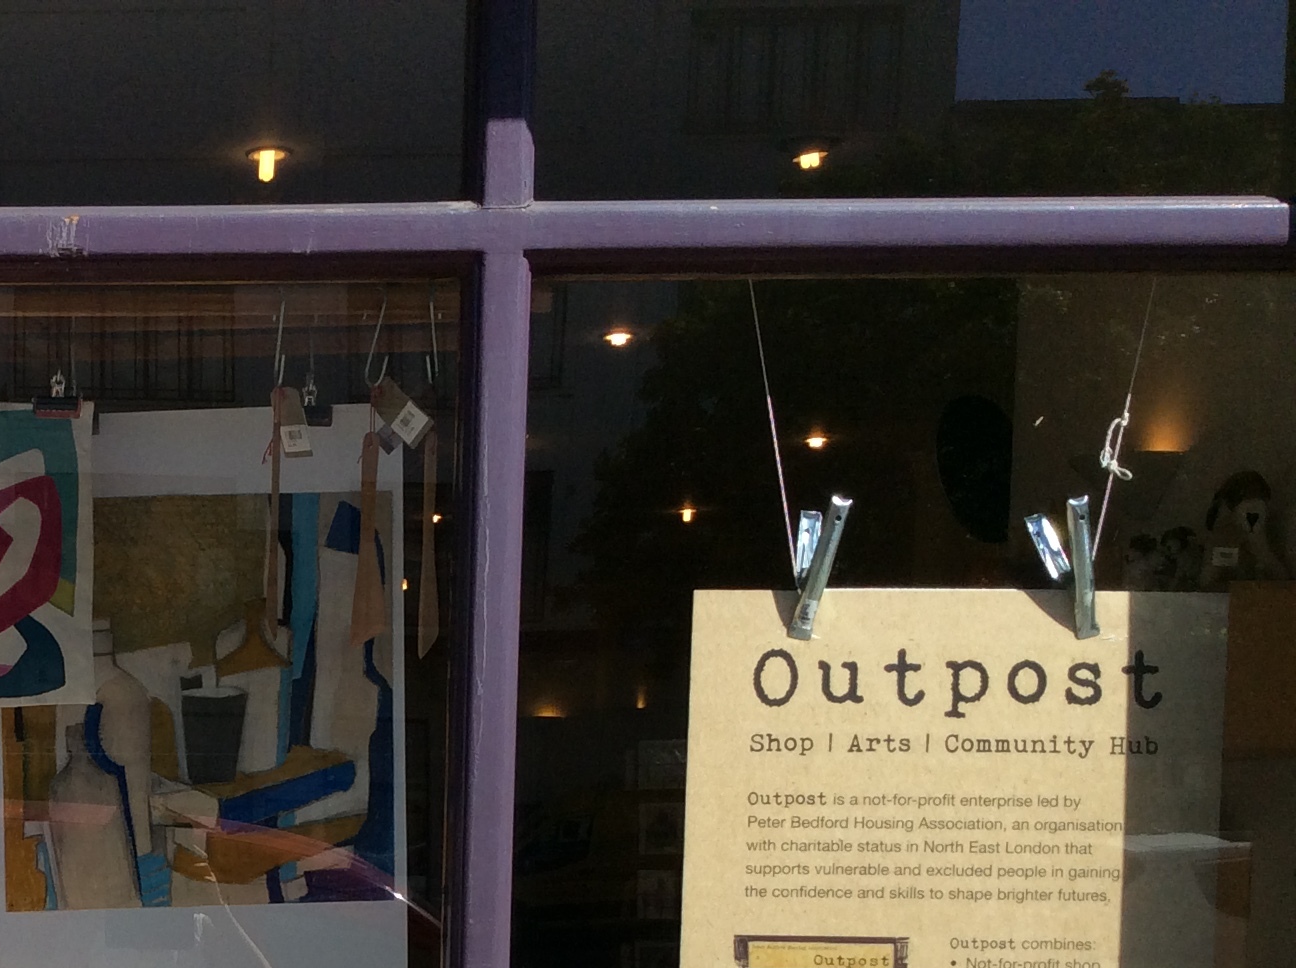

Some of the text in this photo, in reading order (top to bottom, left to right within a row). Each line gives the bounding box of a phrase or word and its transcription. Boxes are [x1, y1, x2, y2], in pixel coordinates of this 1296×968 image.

[753, 648, 1163, 718] Outpost
[749, 733, 814, 755] Shop
[847, 735, 911, 753] Arts
[944, 734, 1095, 759] Community
[1109, 736, 1159, 755] Hub
[747, 791, 1082, 811] Outpost is a not-for-profit enterprise led by
[747, 815, 1123, 833] Peter Bedford Housing Association, an organisation
[746, 839, 1093, 855] with charitable status in North East London that
[745, 863, 1121, 881] supports vulnerable and excluded people in gaining
[745, 886, 767, 897] the
[772, 886, 852, 898] confidence
[857, 887, 885, 898] and
[889, 887, 925, 899] skills
[930, 888, 943, 900] to
[948, 888, 992, 902] shape
[997, 888, 1053, 903] brighter
[950, 938, 1096, 951] Outpost combines:
[813, 954, 890, 968] Outpost
